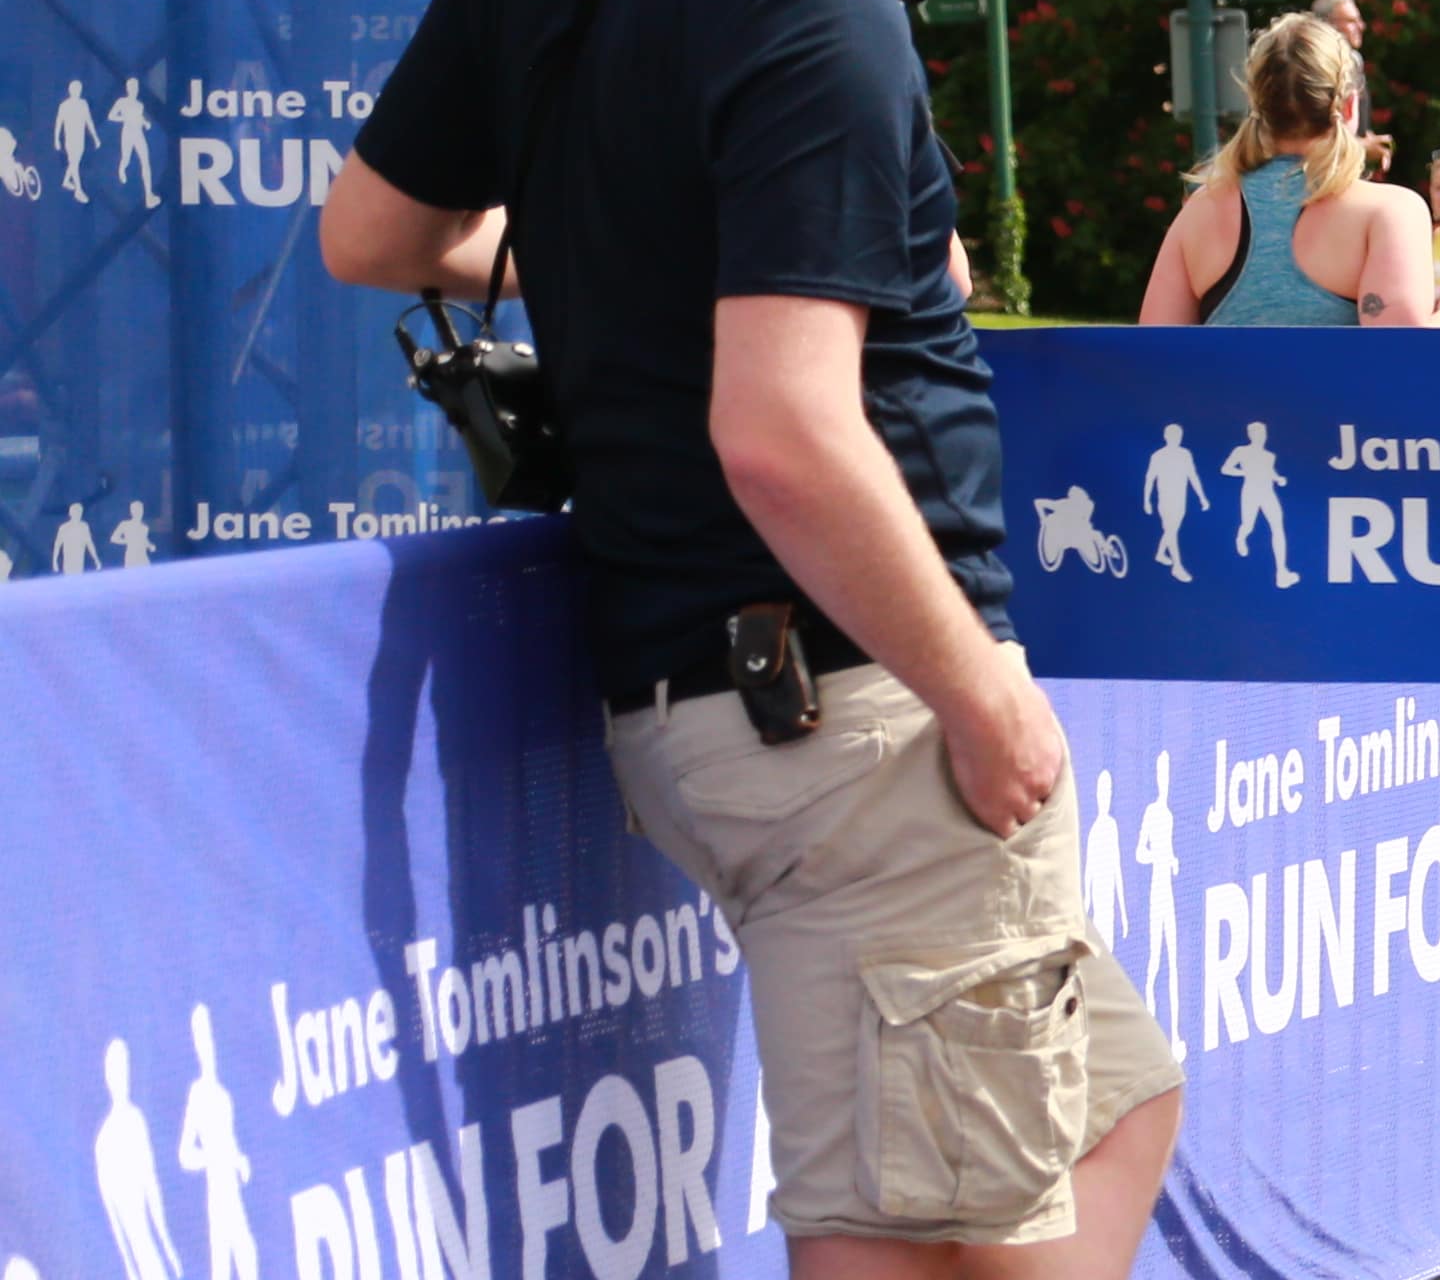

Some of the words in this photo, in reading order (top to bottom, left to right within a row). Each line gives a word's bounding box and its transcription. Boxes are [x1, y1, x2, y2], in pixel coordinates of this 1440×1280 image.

[180, 79, 306, 119] Jane
[187, 503, 311, 540] Jane
[1207, 738, 1304, 833] Jane
[1203, 848, 1356, 1052] RUN
[271, 982, 397, 1117] Jane
[405, 888, 738, 1062] Tomlinson's
